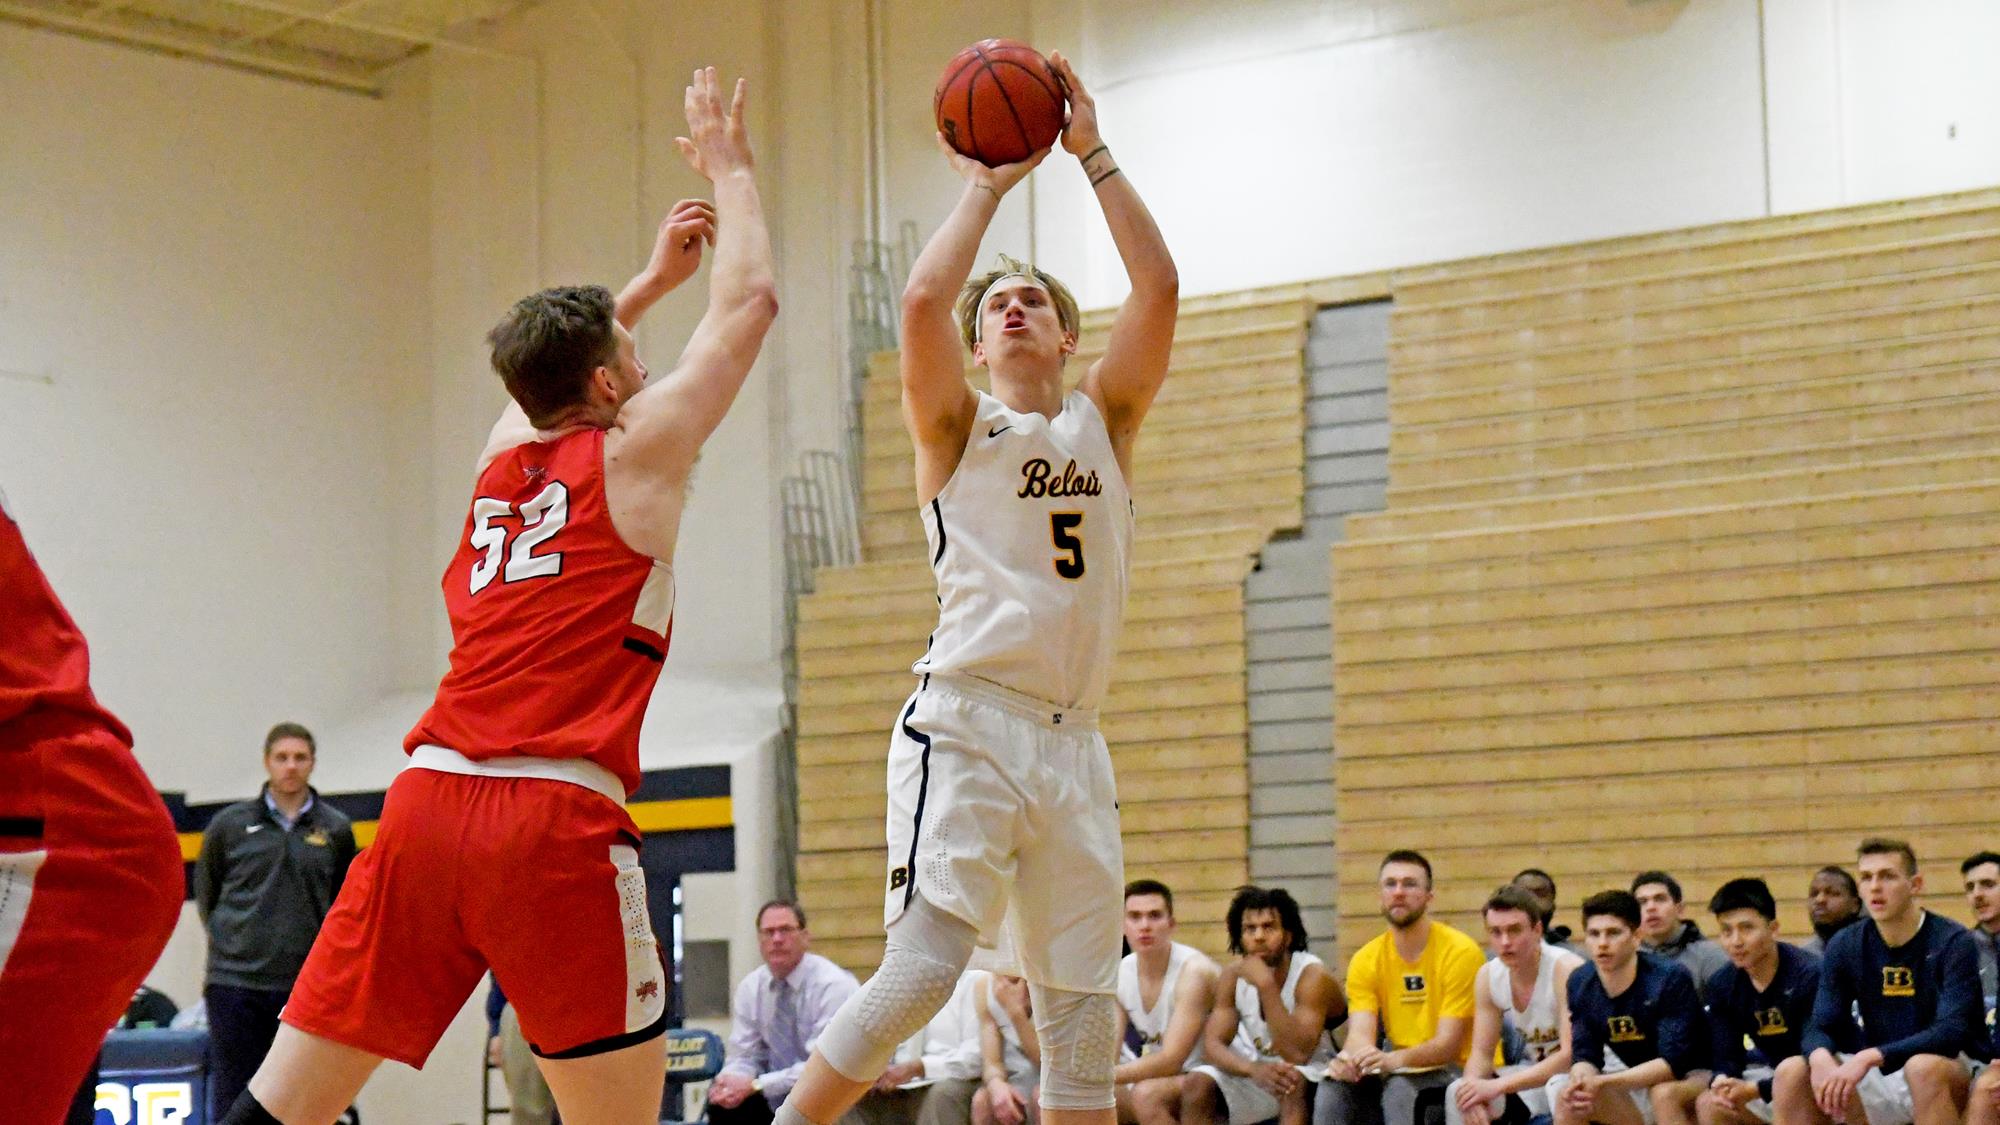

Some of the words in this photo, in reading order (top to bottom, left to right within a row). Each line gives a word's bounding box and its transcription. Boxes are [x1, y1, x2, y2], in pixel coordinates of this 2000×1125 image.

[469, 480, 570, 597] 52
[1049, 511, 1085, 581] 5
[890, 867, 907, 891] B
[1403, 975, 1425, 991] B
